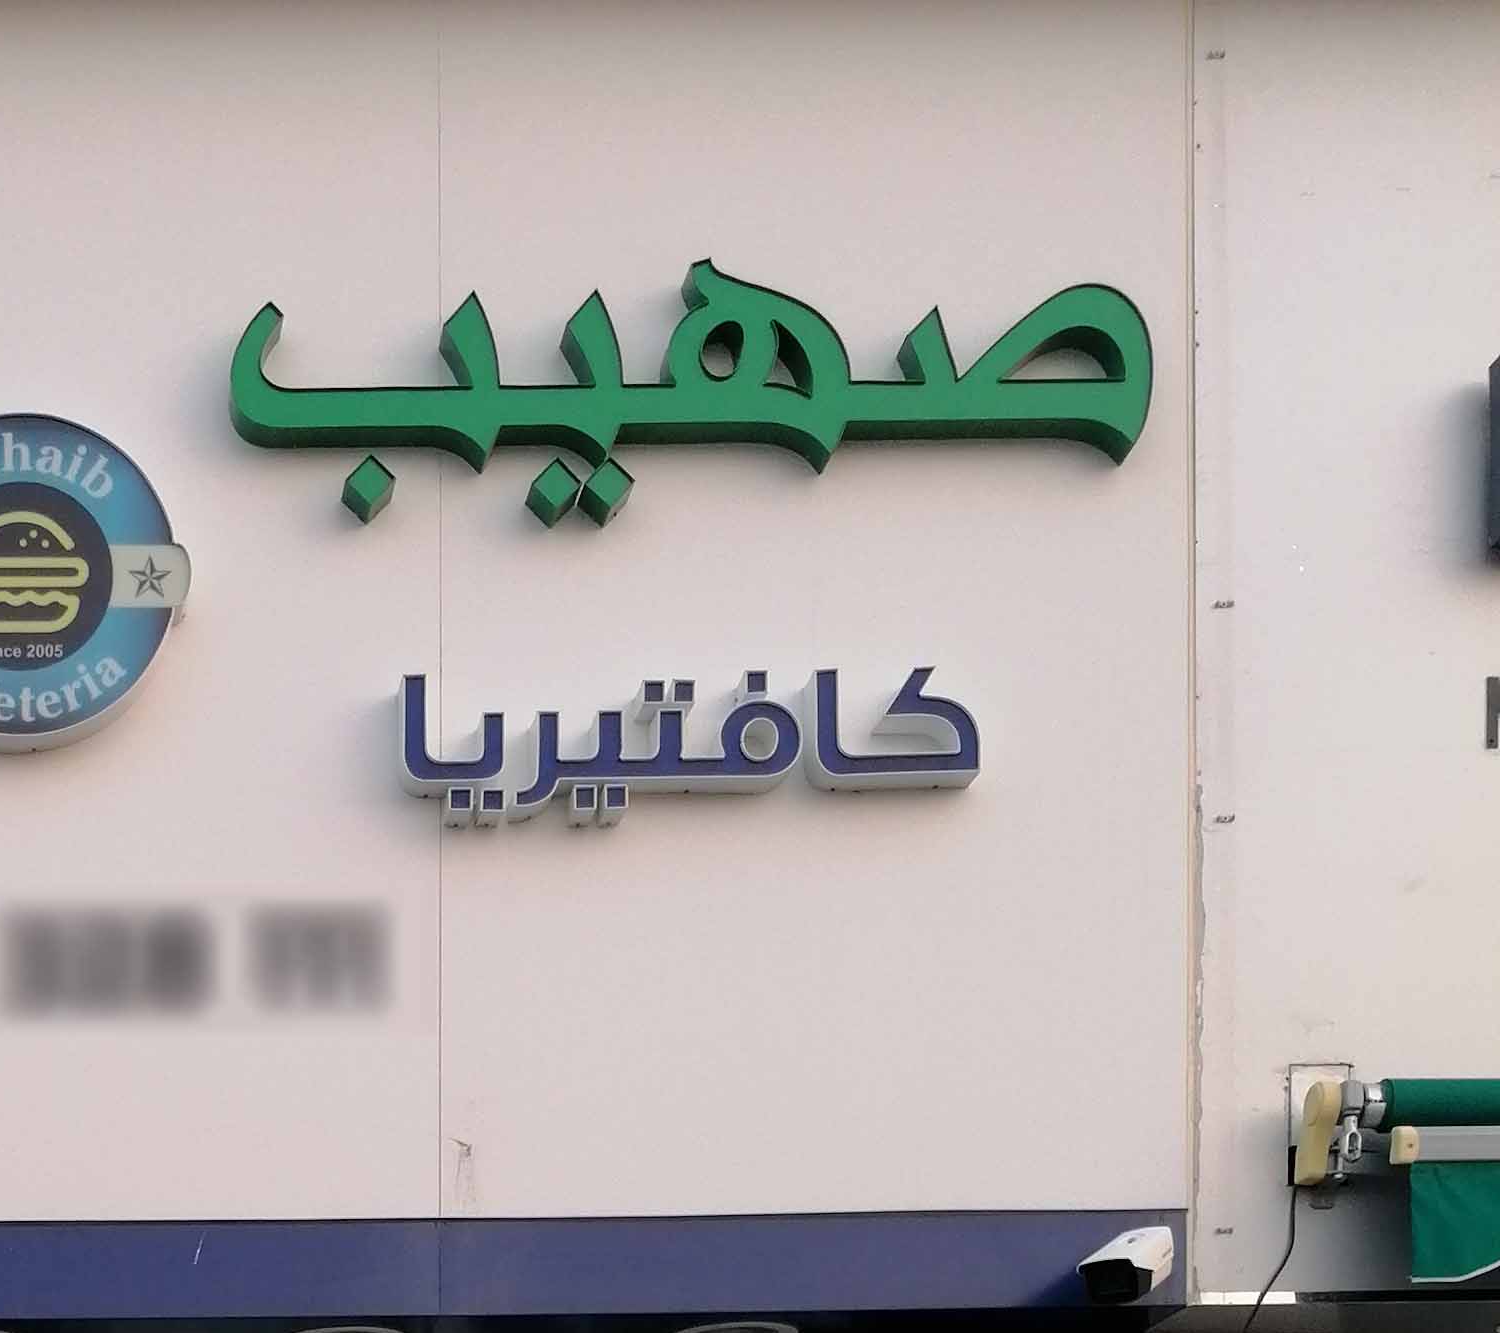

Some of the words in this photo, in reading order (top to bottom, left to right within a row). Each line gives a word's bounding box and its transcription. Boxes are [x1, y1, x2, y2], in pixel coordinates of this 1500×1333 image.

[230, 258, 1153, 526] صهيب
[26, 643, 64, 660] 2005
[397, 666, 980, 828] كافتيريا
